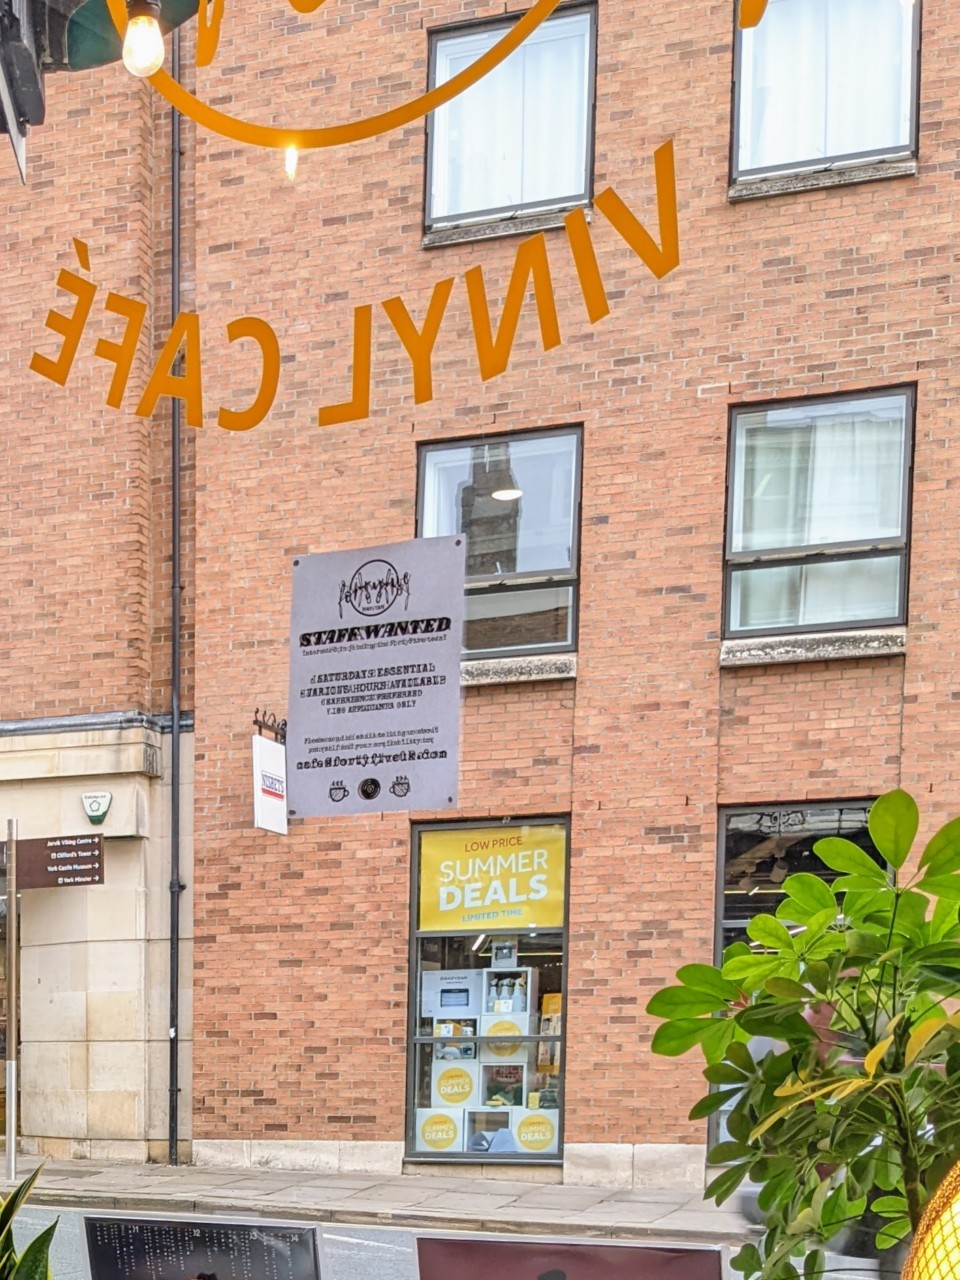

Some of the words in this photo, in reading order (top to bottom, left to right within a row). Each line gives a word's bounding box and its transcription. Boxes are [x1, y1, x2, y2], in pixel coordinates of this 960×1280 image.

[364, 617, 451, 640] WANTED
[378, 663, 435, 678] ESSENTIAL
[261, 771, 285, 793] NISBETS
[61, 839, 76, 847] Viking
[465, 841, 490, 853] LOW
[492, 836, 523, 849] PRICE
[439, 849, 548, 883] SUMMER
[439, 874, 549, 911] DEALS
[462, 912, 499, 922] LIMITED
[501, 908, 523, 918] TIME
[440, 1085, 470, 1094] DEALS
[425, 1130, 454, 1140] DEALS
[521, 1131, 551, 1140] DEALS
